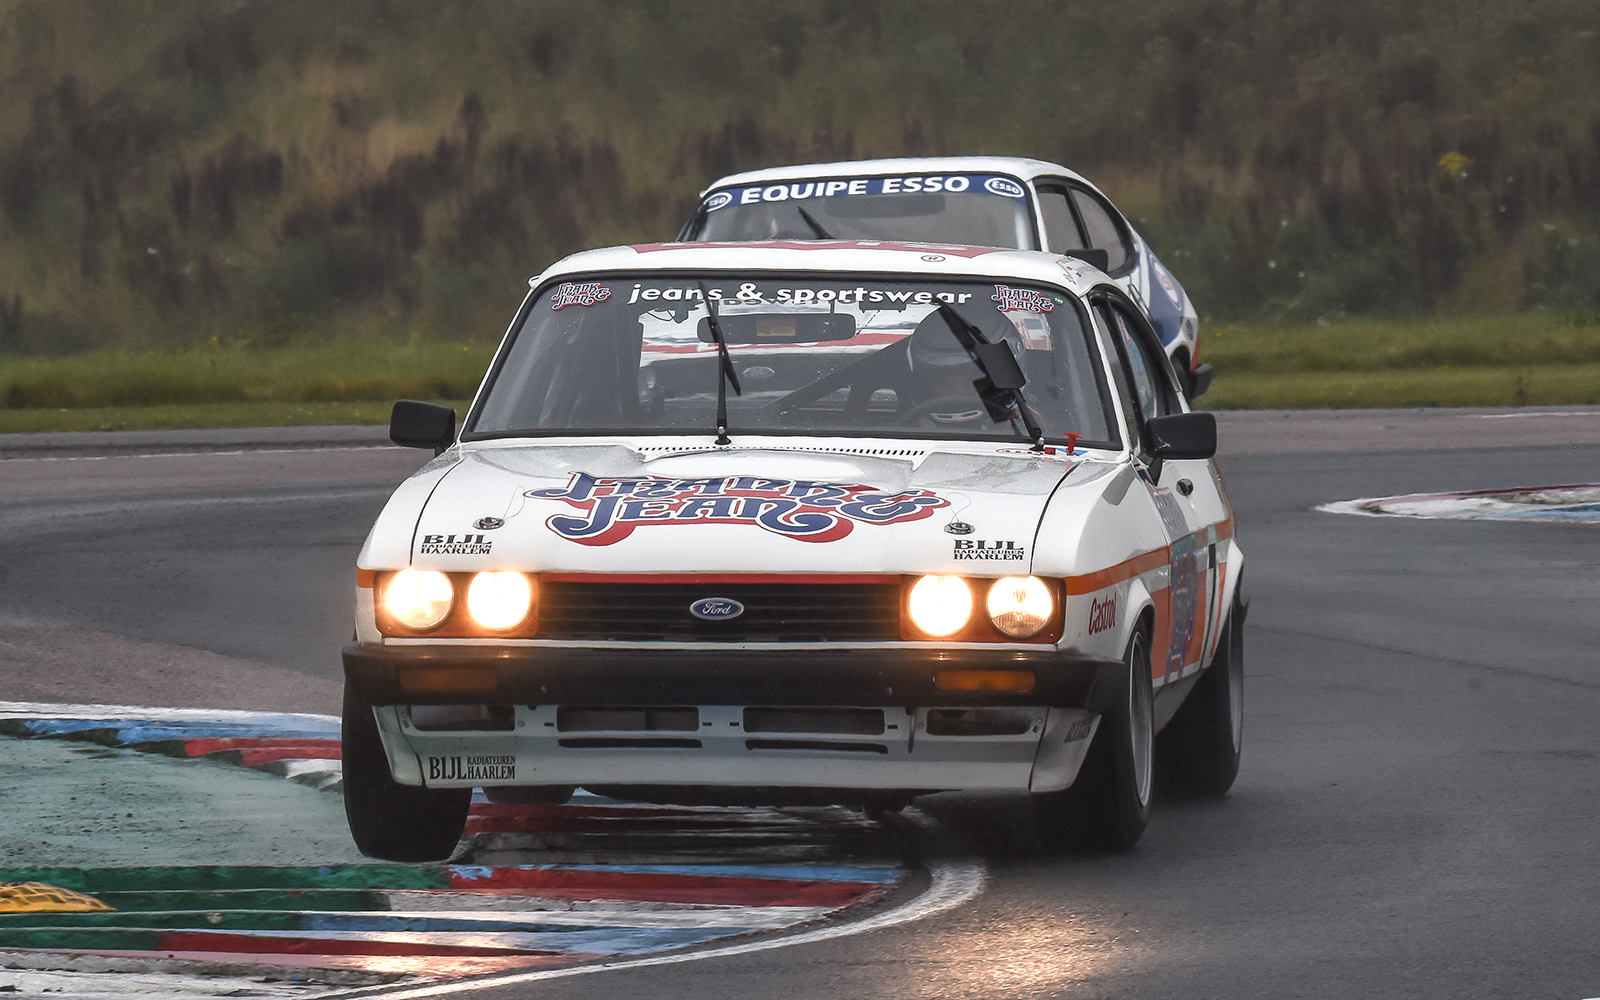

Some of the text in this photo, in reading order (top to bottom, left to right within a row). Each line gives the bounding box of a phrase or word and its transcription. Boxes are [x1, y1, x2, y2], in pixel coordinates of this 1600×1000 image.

[740, 176, 970, 204] EQUIPE ESSO
[627, 283, 972, 305] jeans & sportswear
[423, 534, 493, 544] BIJL
[954, 539, 1024, 550] BIJL
[702, 602, 732, 615] Ford
[1088, 592, 1117, 636] Castrol
[428, 755, 516, 780] BIJL RADIATEUREN
[466, 765, 516, 780] HAARLEM
